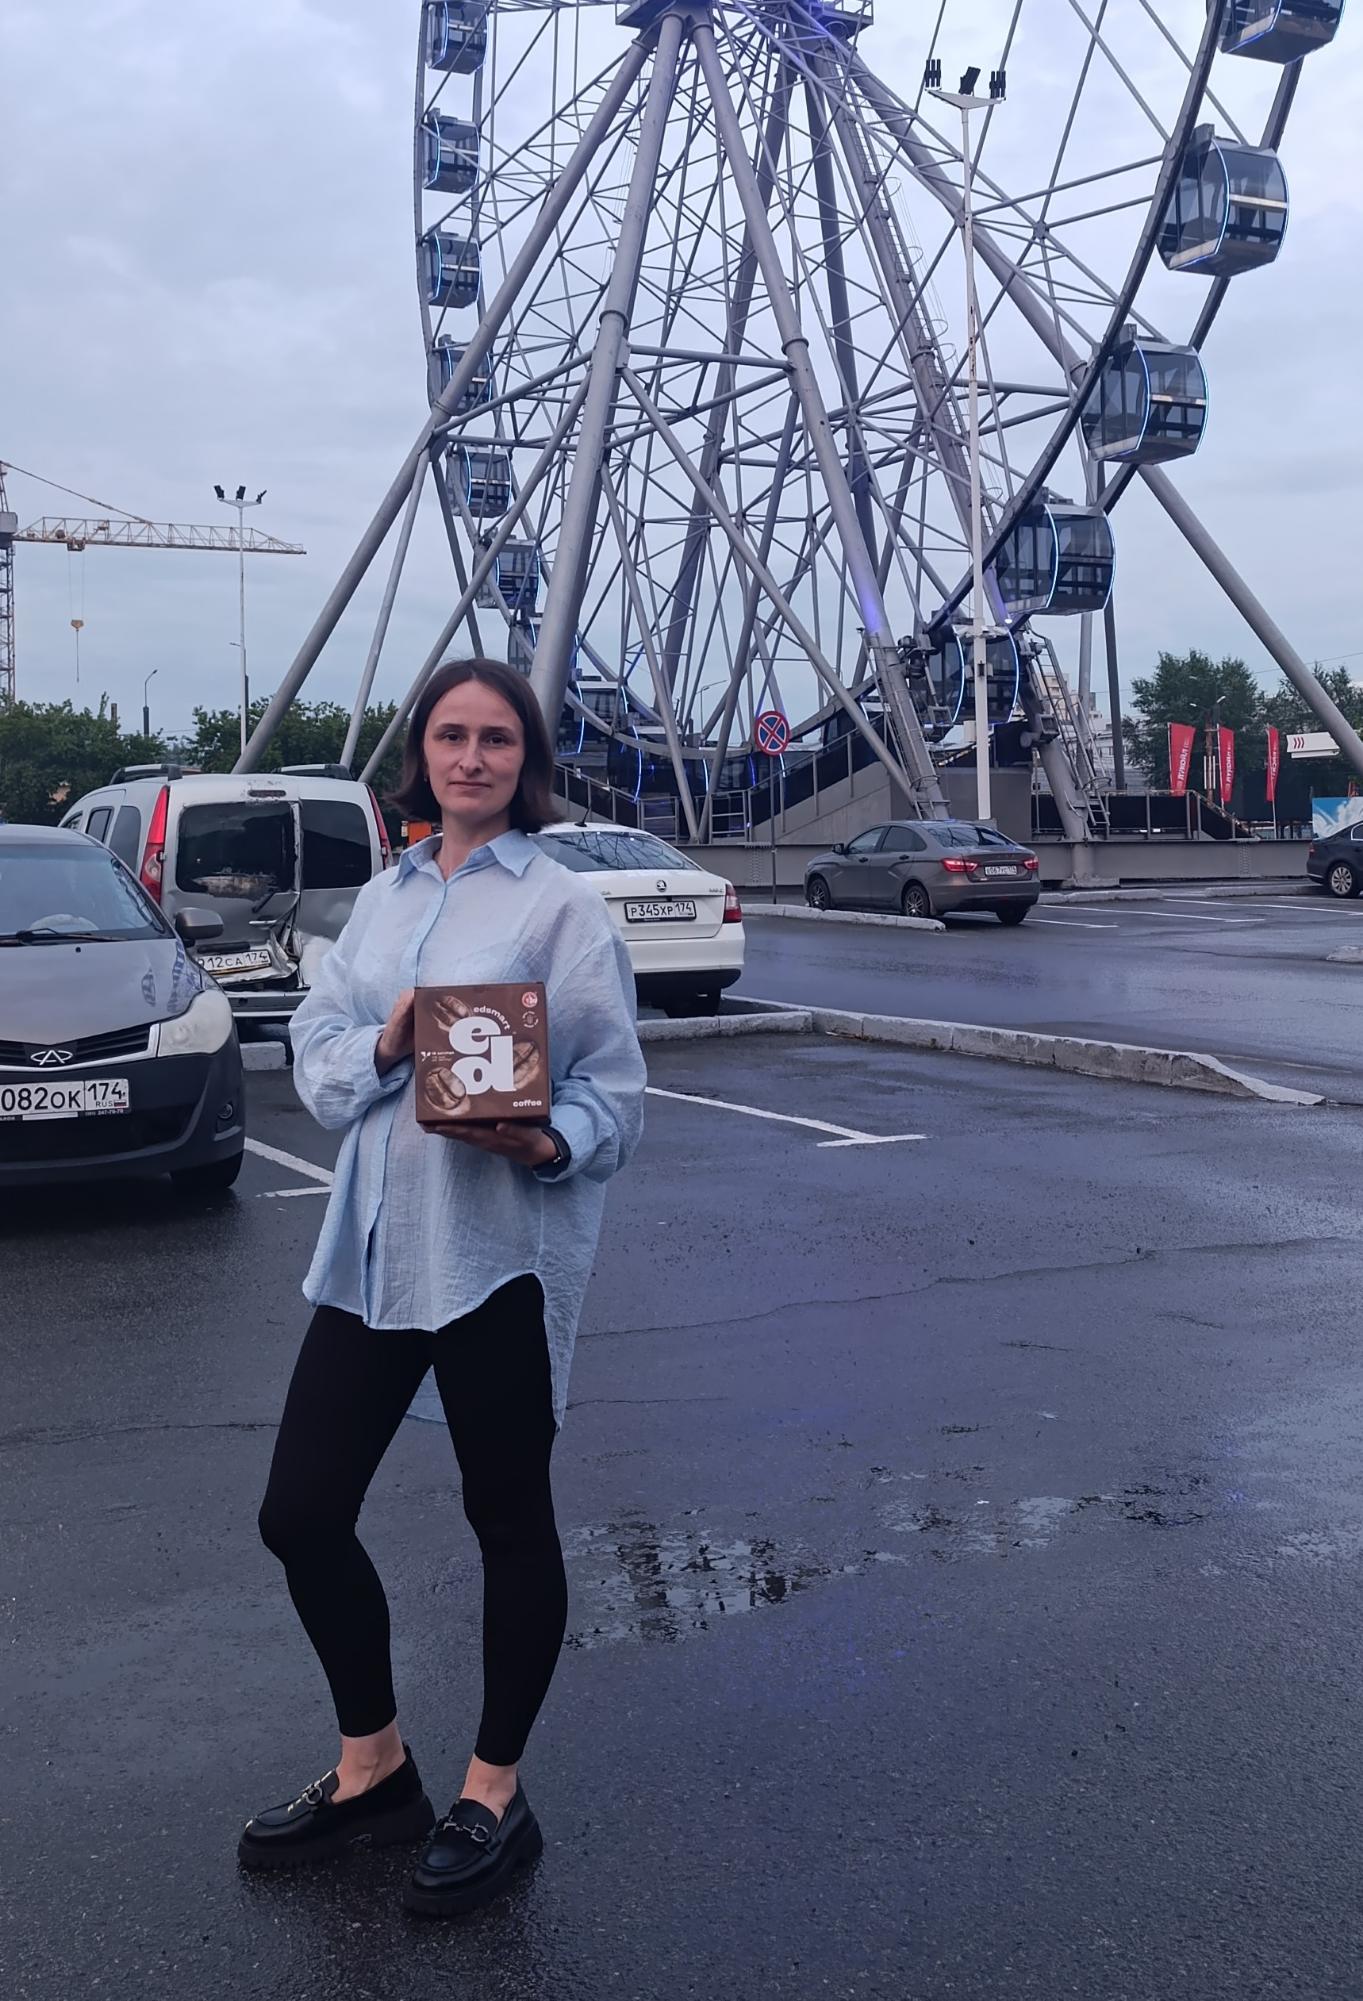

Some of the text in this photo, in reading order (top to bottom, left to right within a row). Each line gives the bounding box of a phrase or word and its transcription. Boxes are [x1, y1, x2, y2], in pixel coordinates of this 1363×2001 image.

[631, 902, 692, 916] Р345ХР 174
[246, 952, 268, 962] 174
[473, 1005, 511, 1030] edsmart
[87, 1082, 122, 1101] 174
[513, 1099, 542, 1108] coffee
